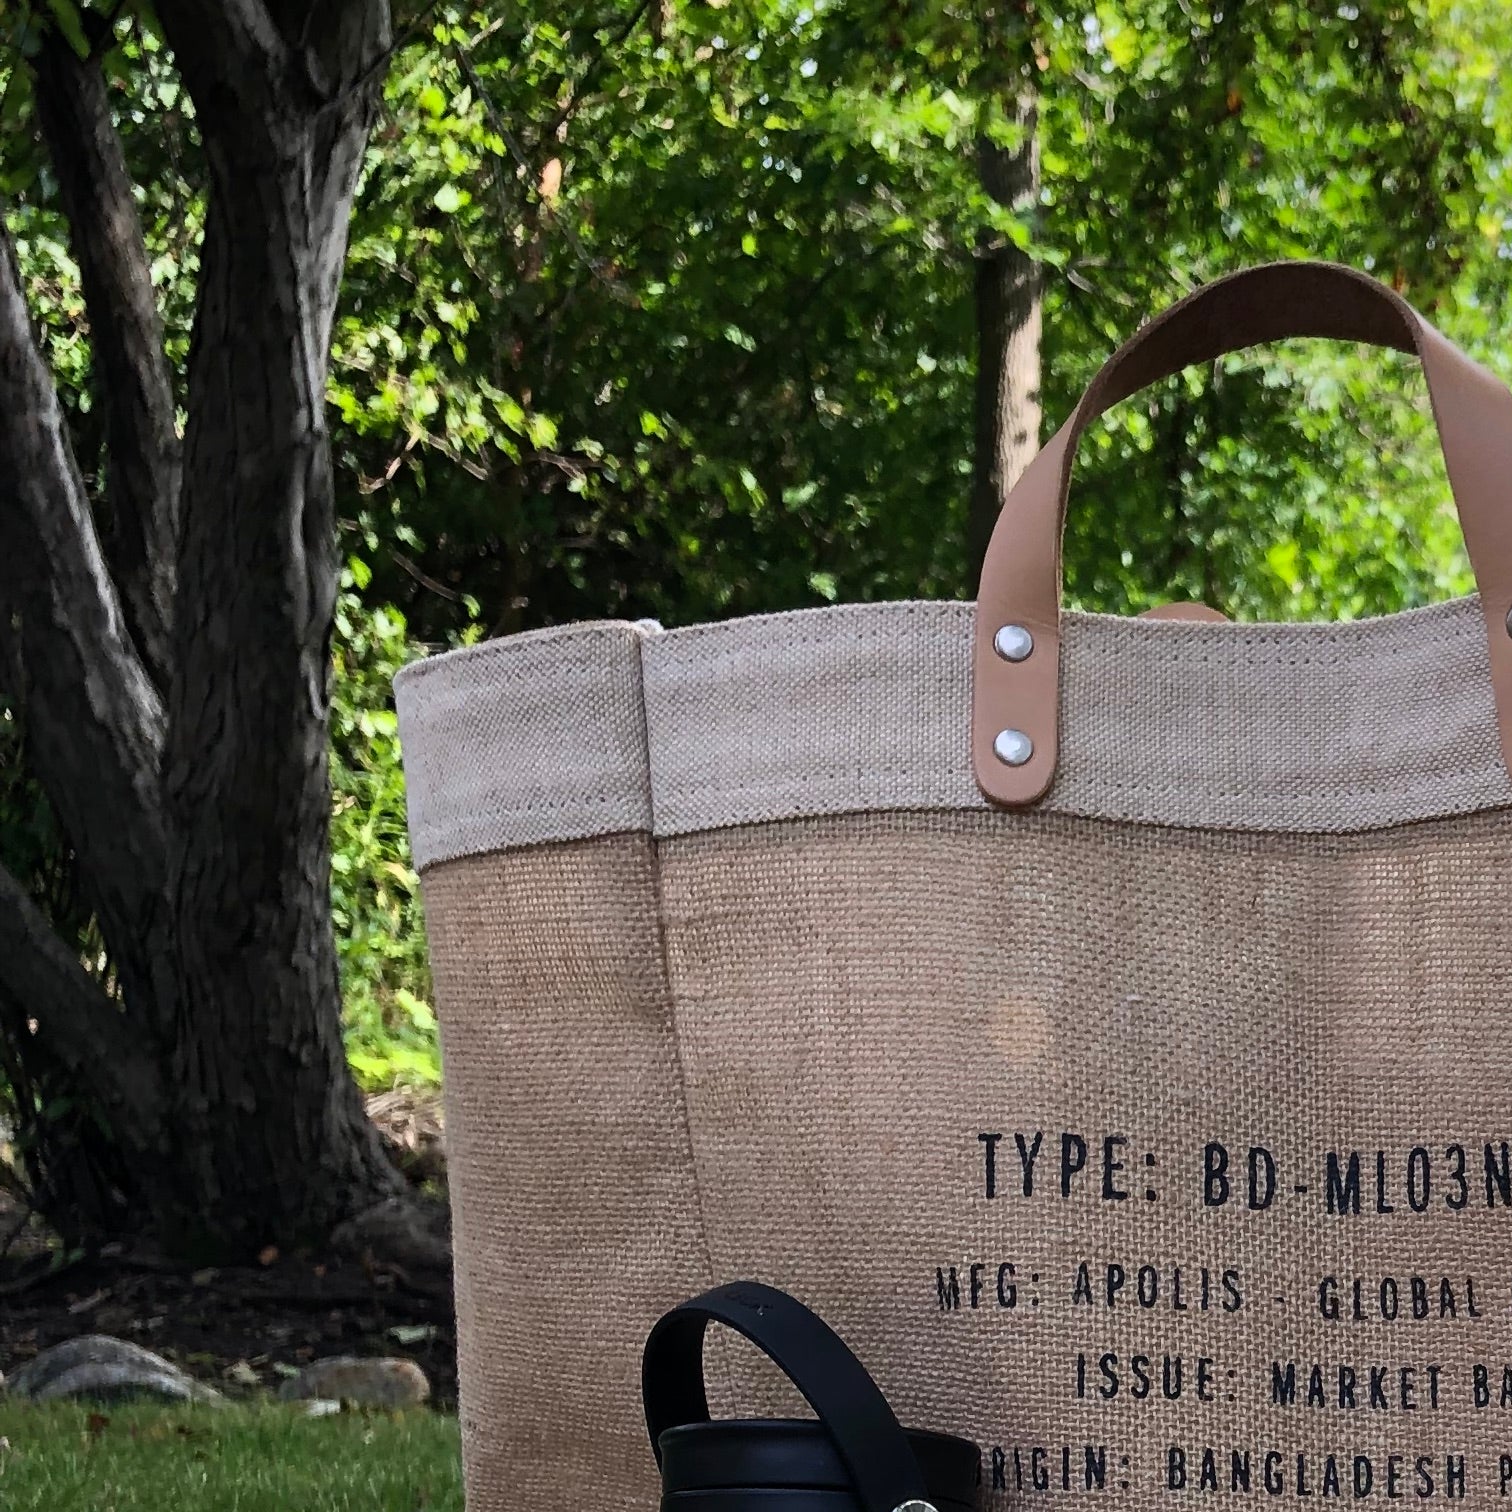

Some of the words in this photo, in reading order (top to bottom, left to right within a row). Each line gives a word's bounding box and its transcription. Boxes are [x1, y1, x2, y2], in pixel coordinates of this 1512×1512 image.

[977, 1131, 1157, 1202] TYPE:
[936, 1263, 1040, 1311] MFG:
[1073, 1261, 1242, 1313] APOLIS
[1319, 1276, 1482, 1321] GLOBAL
[1077, 1353, 1236, 1402] ISSUE:
[1271, 1361, 1441, 1410] MARKET
[1167, 1446, 1465, 1499] BANGLADESH
